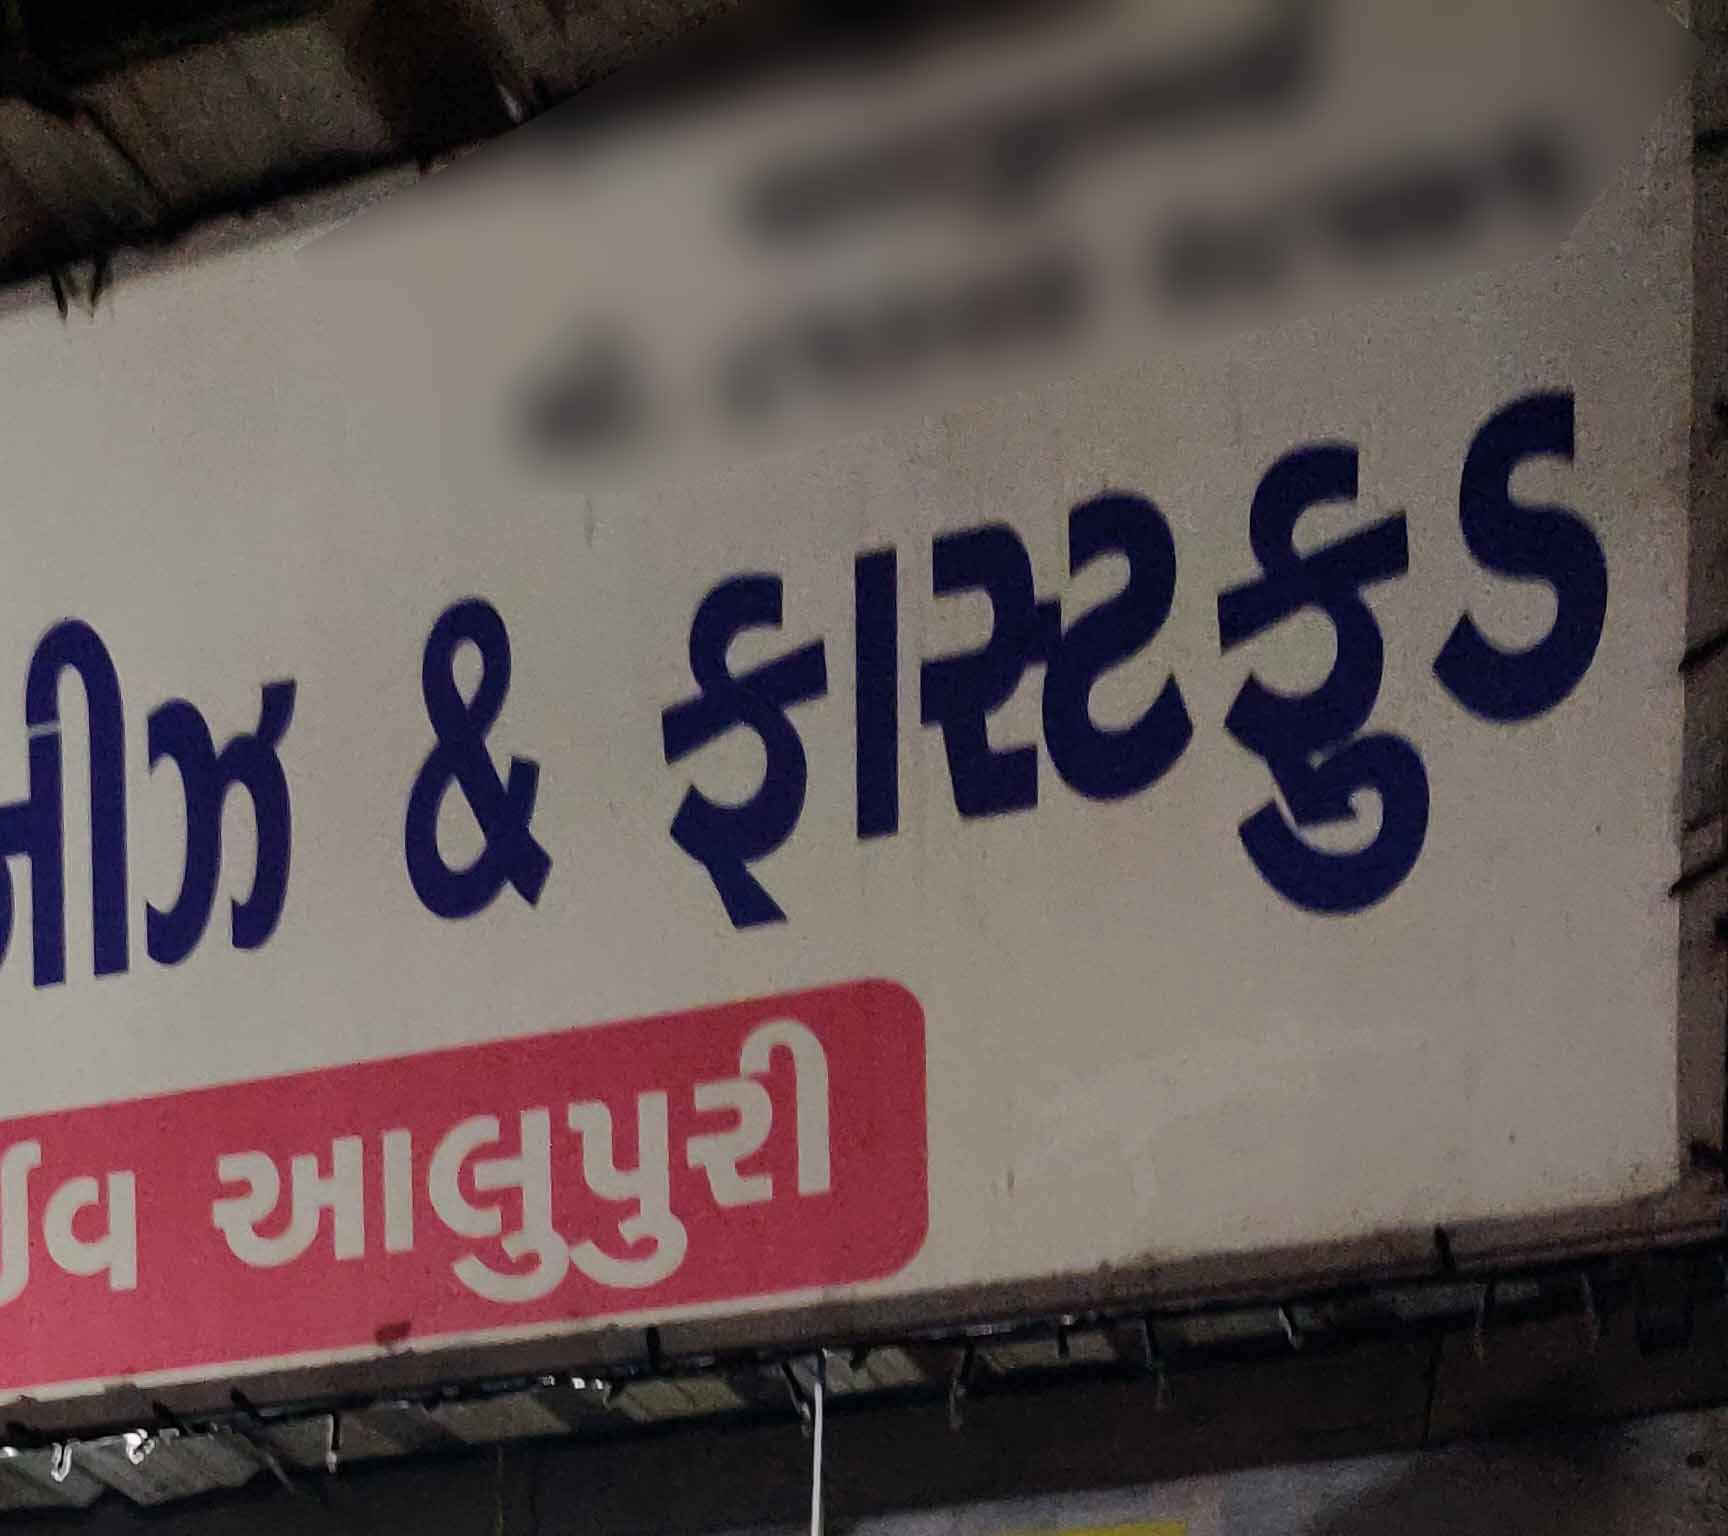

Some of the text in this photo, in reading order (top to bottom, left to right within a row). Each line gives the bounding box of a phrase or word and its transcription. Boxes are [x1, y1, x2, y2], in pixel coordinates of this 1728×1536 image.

[404, 597, 553, 921] &
[661, 390, 1609, 930] ફાસ્ટફુડ
[212, 1021, 830, 1302] આલુપુરી
